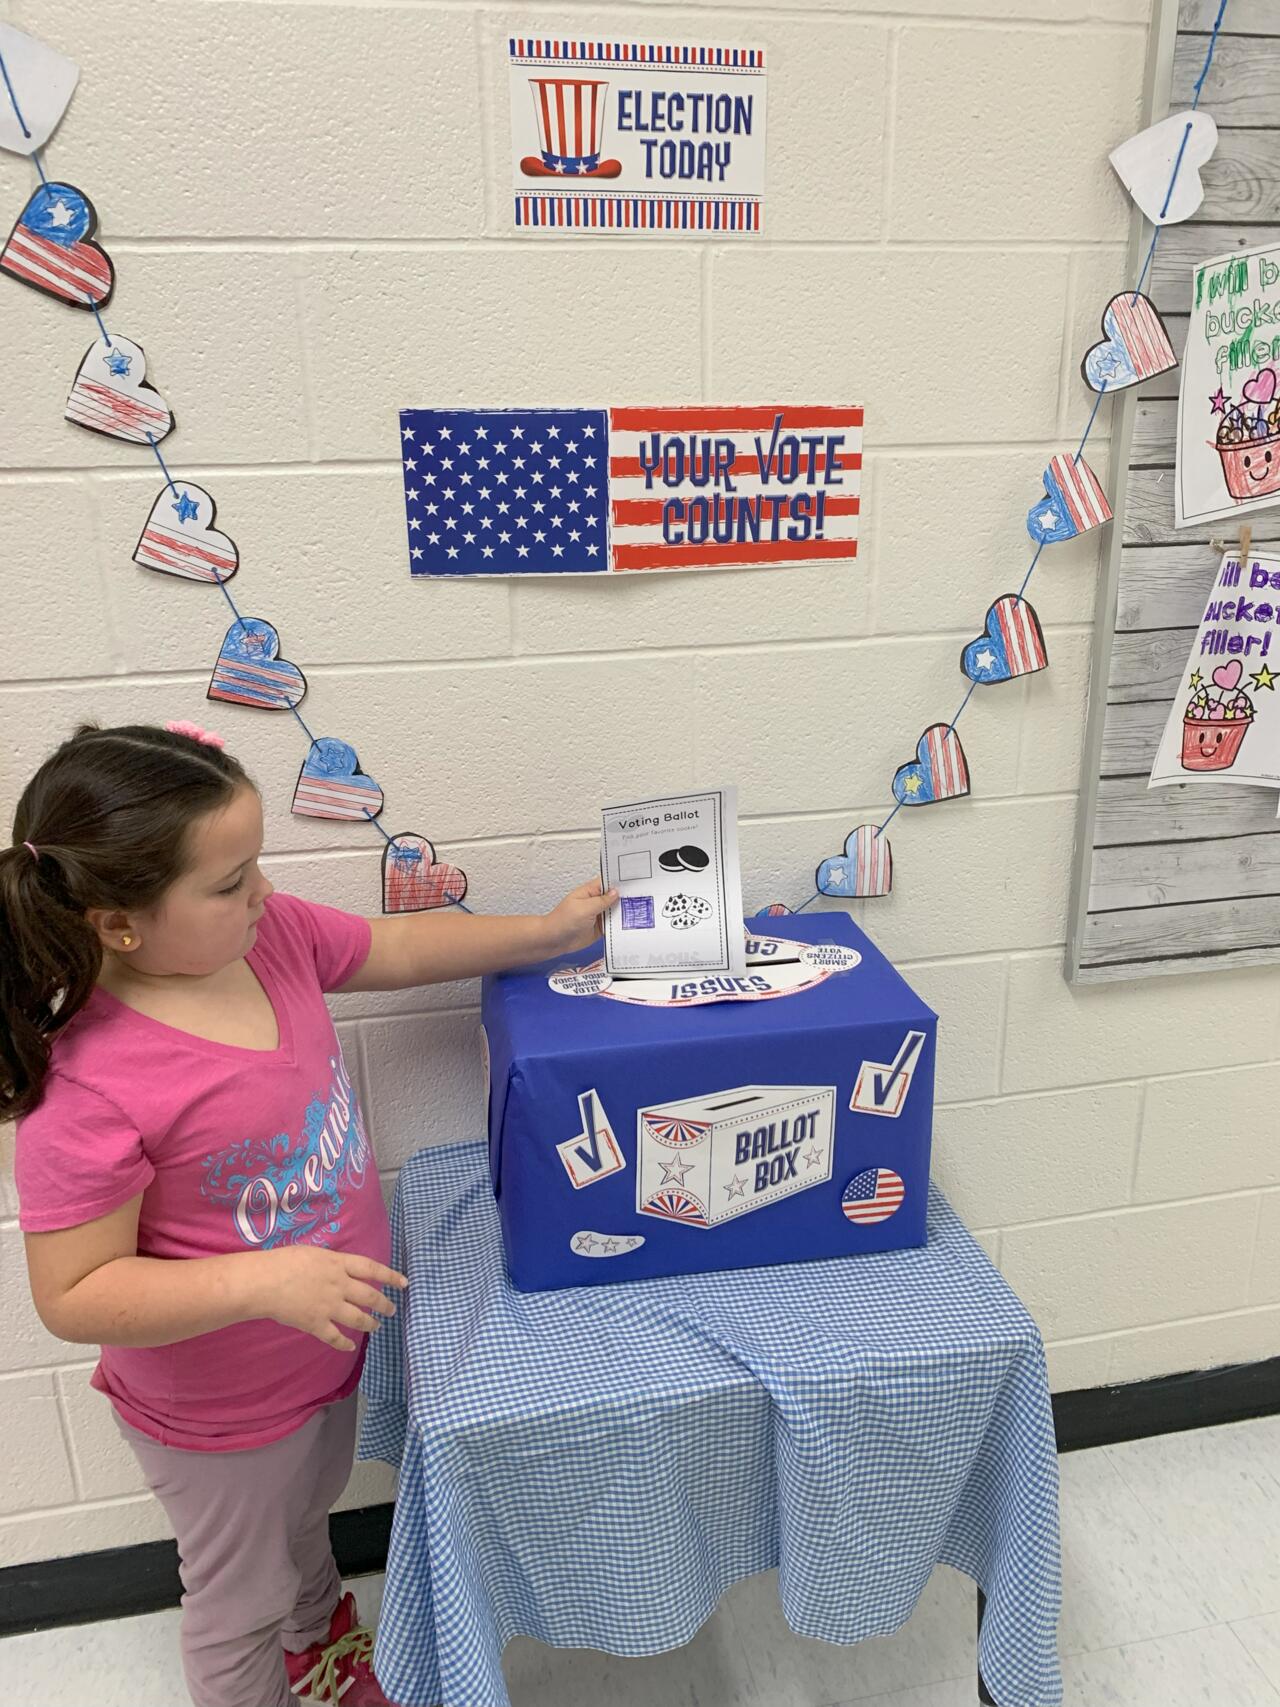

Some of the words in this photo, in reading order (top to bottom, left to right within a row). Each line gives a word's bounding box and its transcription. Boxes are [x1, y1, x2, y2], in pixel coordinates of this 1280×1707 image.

[617, 90, 753, 136] ELECTION
[639, 138, 731, 182] TODAY
[1195, 269, 1205, 308] I
[1208, 261, 1249, 299] will
[639, 432, 737, 492] YOUR
[754, 413, 845, 485] VOTE
[662, 489, 826, 545] COUNTS!
[1200, 628, 1272, 657] filler!
[618, 815, 660, 830] Voting
[663, 810, 700, 822] Ballot
[806, 952, 853, 960] CITIZENS
[813, 958, 848, 966] SMART
[552, 975, 578, 985] VOICE
[582, 972, 606, 981] YOUR
[572, 985, 600, 994] VOTE!
[671, 975, 772, 999] ISSUES
[734, 1109, 820, 1166] BALLOT
[753, 1146, 802, 1193] BOX
